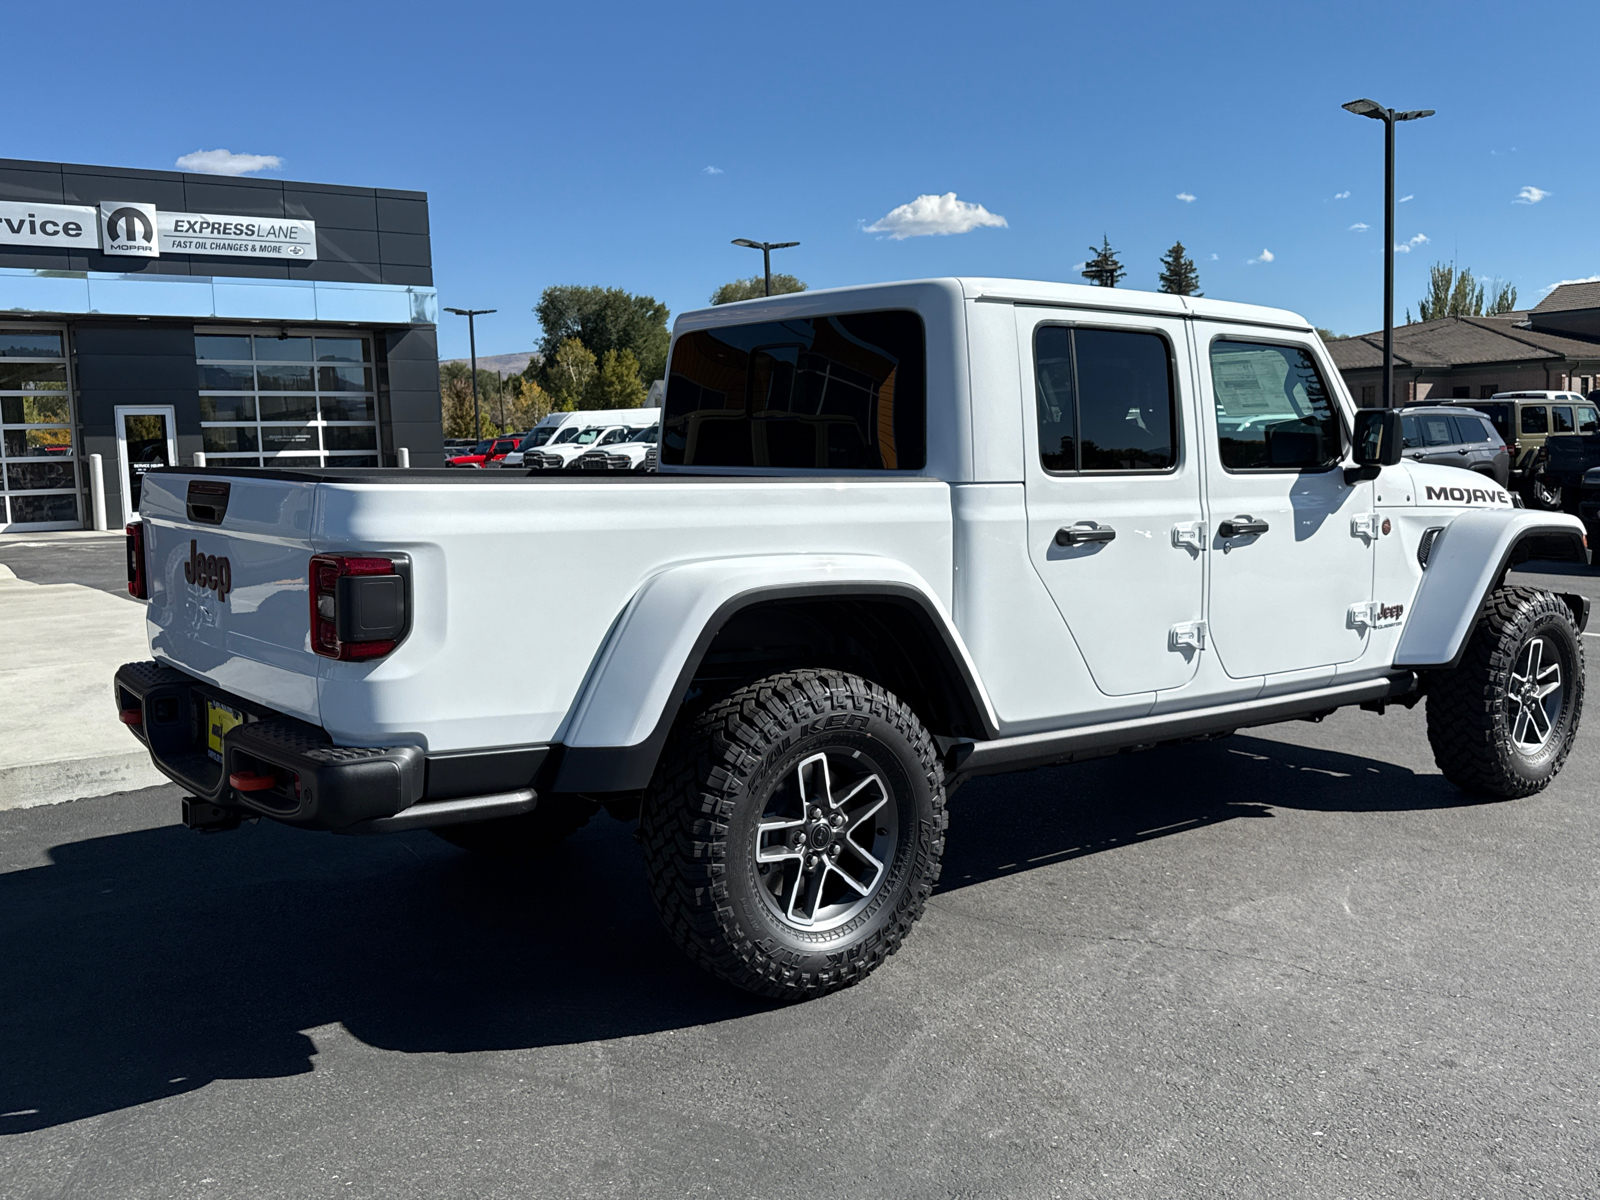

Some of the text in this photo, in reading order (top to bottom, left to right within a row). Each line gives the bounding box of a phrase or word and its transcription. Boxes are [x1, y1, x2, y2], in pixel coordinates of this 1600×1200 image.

[0, 213, 83, 238] vice
[110, 244, 152, 252] MOPAR
[172, 240, 193, 249] FAST
[195, 241, 208, 250] OIL
[209, 242, 249, 252] CHANGES
[250, 244, 256, 252] &
[258, 245, 282, 253] MORE
[1425, 486, 1509, 504] MOJAVE
[184, 539, 231, 603] Jeep
[1377, 603, 1403, 621] Jeep
[822, 819, 932, 969] WILDPEAK
